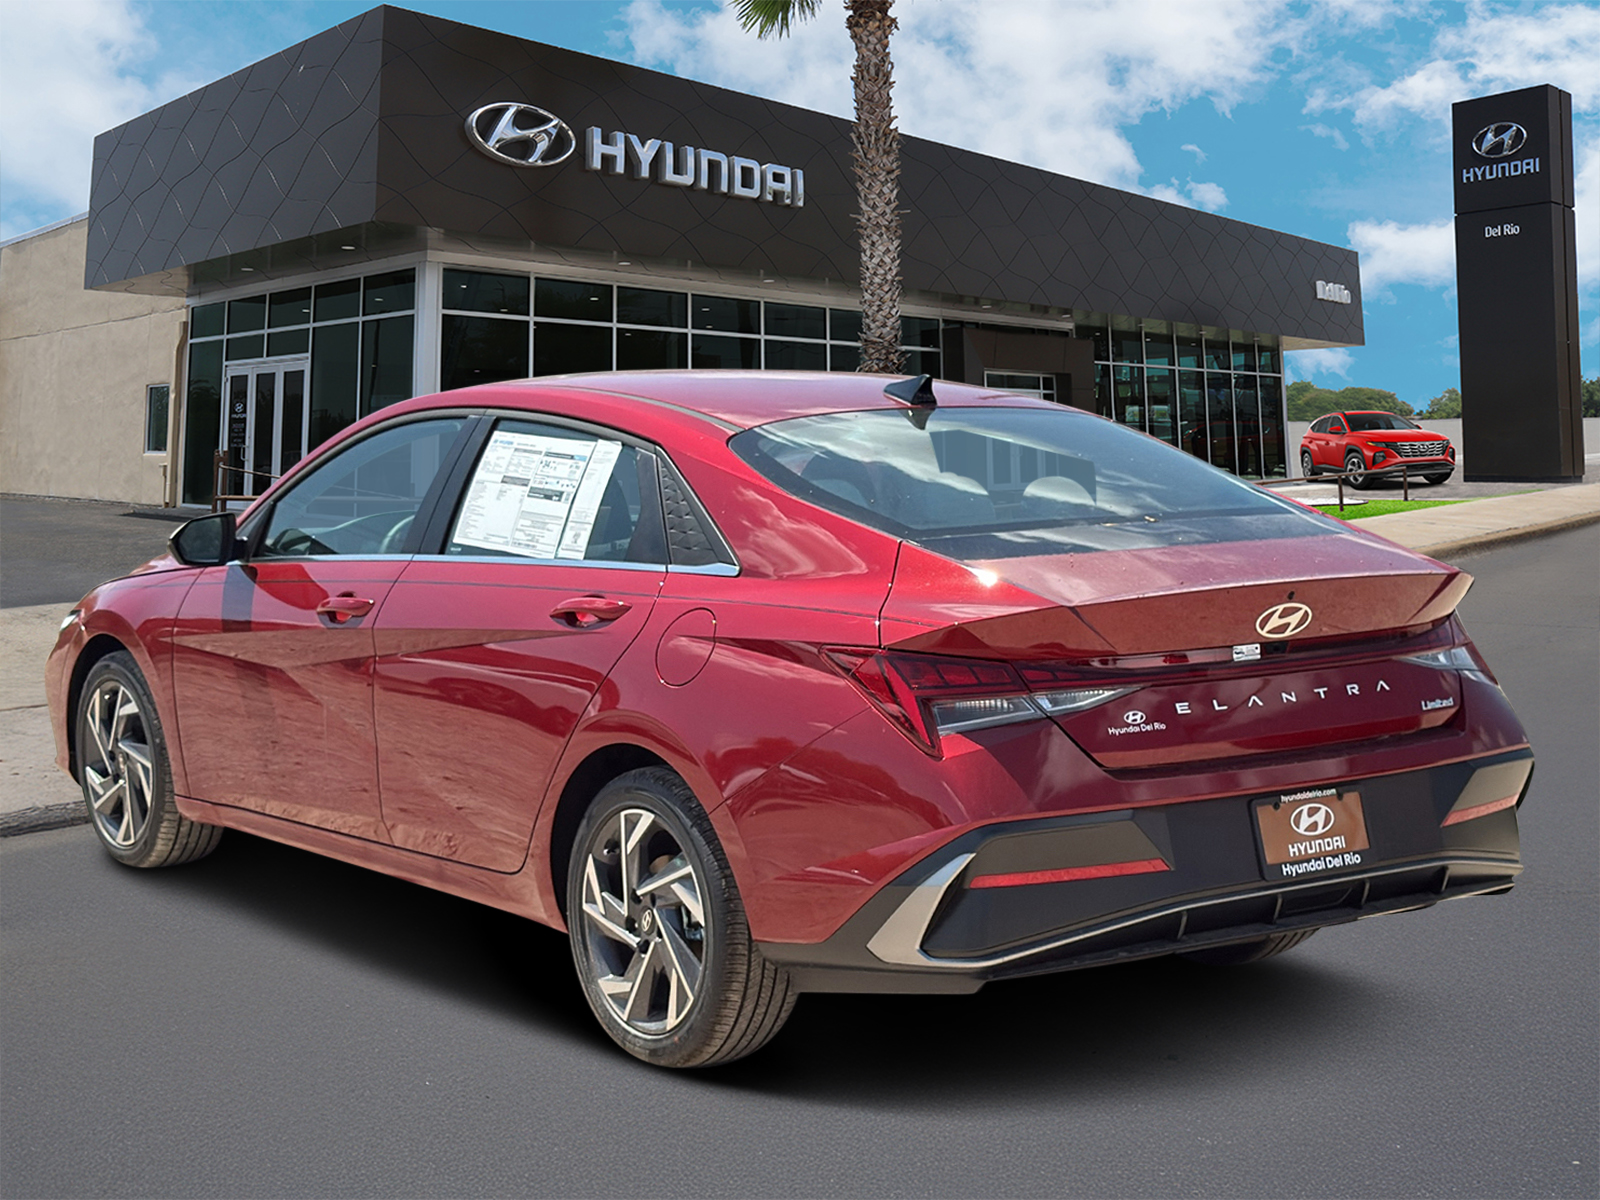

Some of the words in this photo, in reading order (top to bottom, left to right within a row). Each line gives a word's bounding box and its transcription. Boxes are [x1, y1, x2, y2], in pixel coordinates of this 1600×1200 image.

[586, 125, 804, 208] HYUNDAI
[1462, 157, 1540, 184] HYUNDAI
[1484, 225, 1501, 238] Del
[1503, 223, 1520, 236] Rio
[1174, 680, 1390, 715] ELANTRA
[1421, 696, 1454, 711] Limited
[1108, 725, 1140, 737] Hyundai
[1140, 723, 1153, 732] Del
[1154, 722, 1166, 731] Rio
[1281, 788, 1337, 803] hyundaidelrio.com
[1288, 835, 1346, 857] HYUNDAI
[1281, 857, 1326, 877] Hyundai
[1326, 855, 1343, 869] Del
[1344, 852, 1361, 865] Rio
